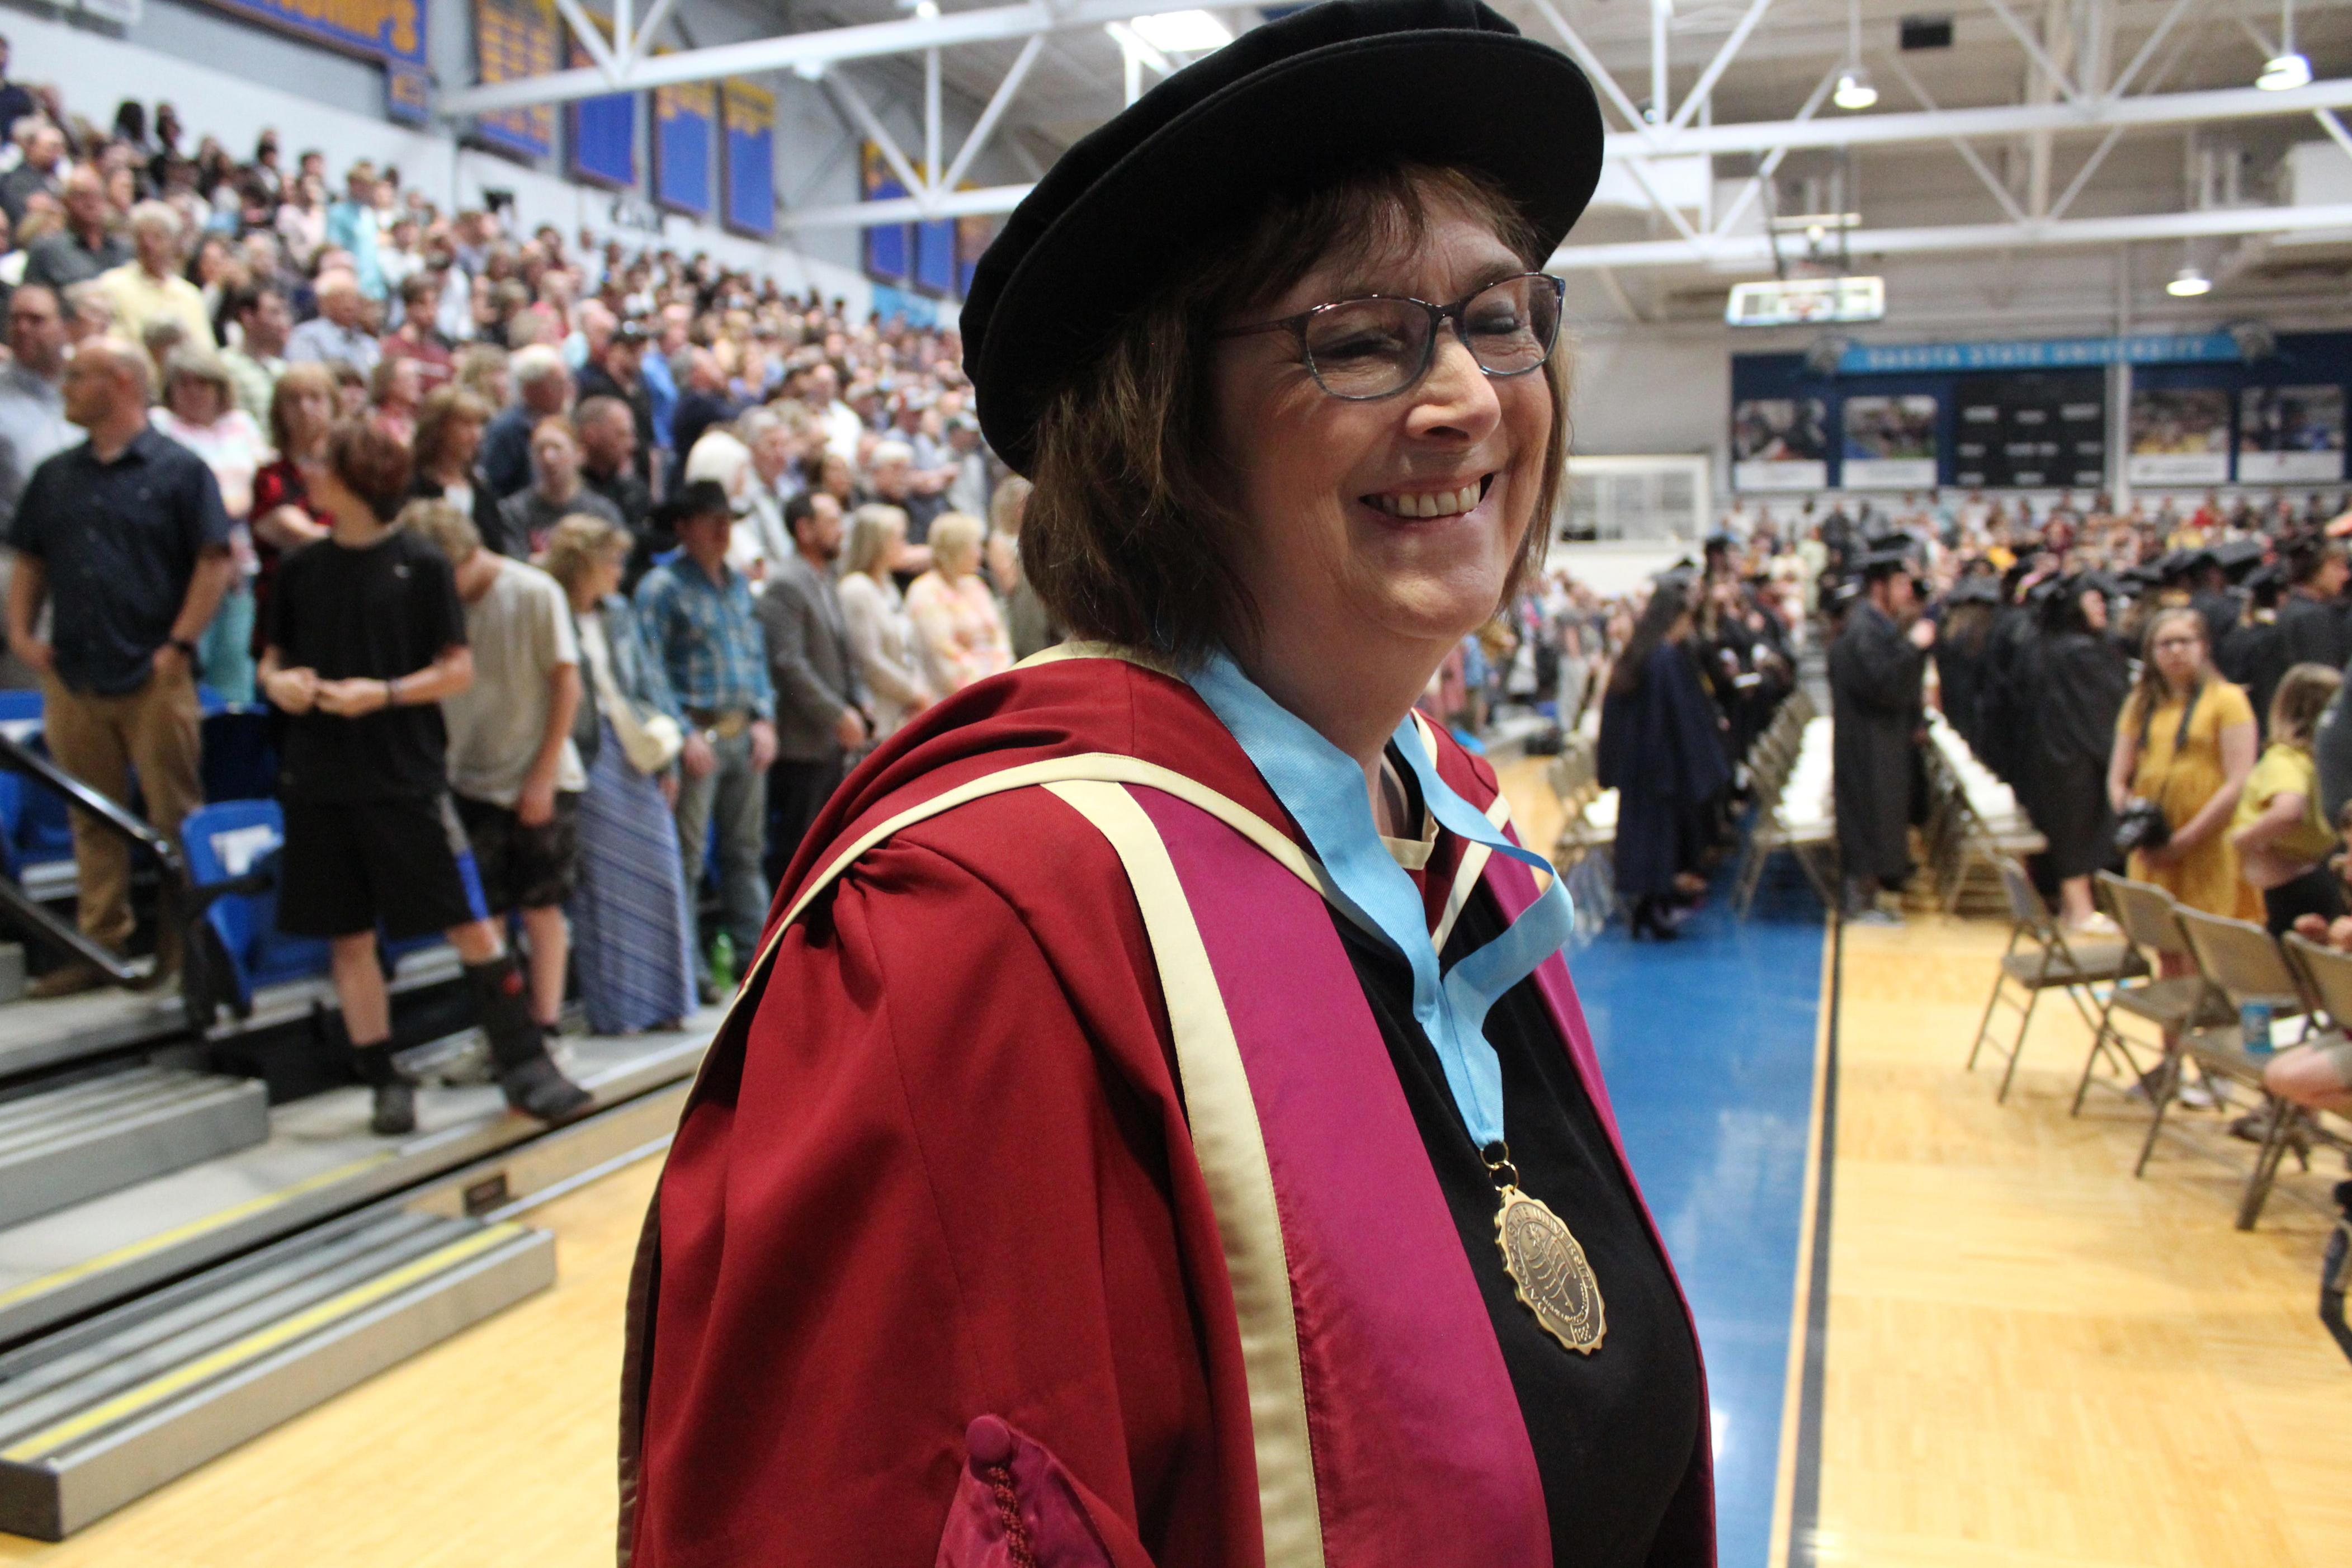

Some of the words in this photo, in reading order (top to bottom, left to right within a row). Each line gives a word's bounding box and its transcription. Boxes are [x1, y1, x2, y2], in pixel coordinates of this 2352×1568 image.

[1508, 1206, 1531, 1239] STATE
[1532, 1207, 1594, 1291] UNIVERSITY
[1508, 1242, 1547, 1315] DAKOTA
